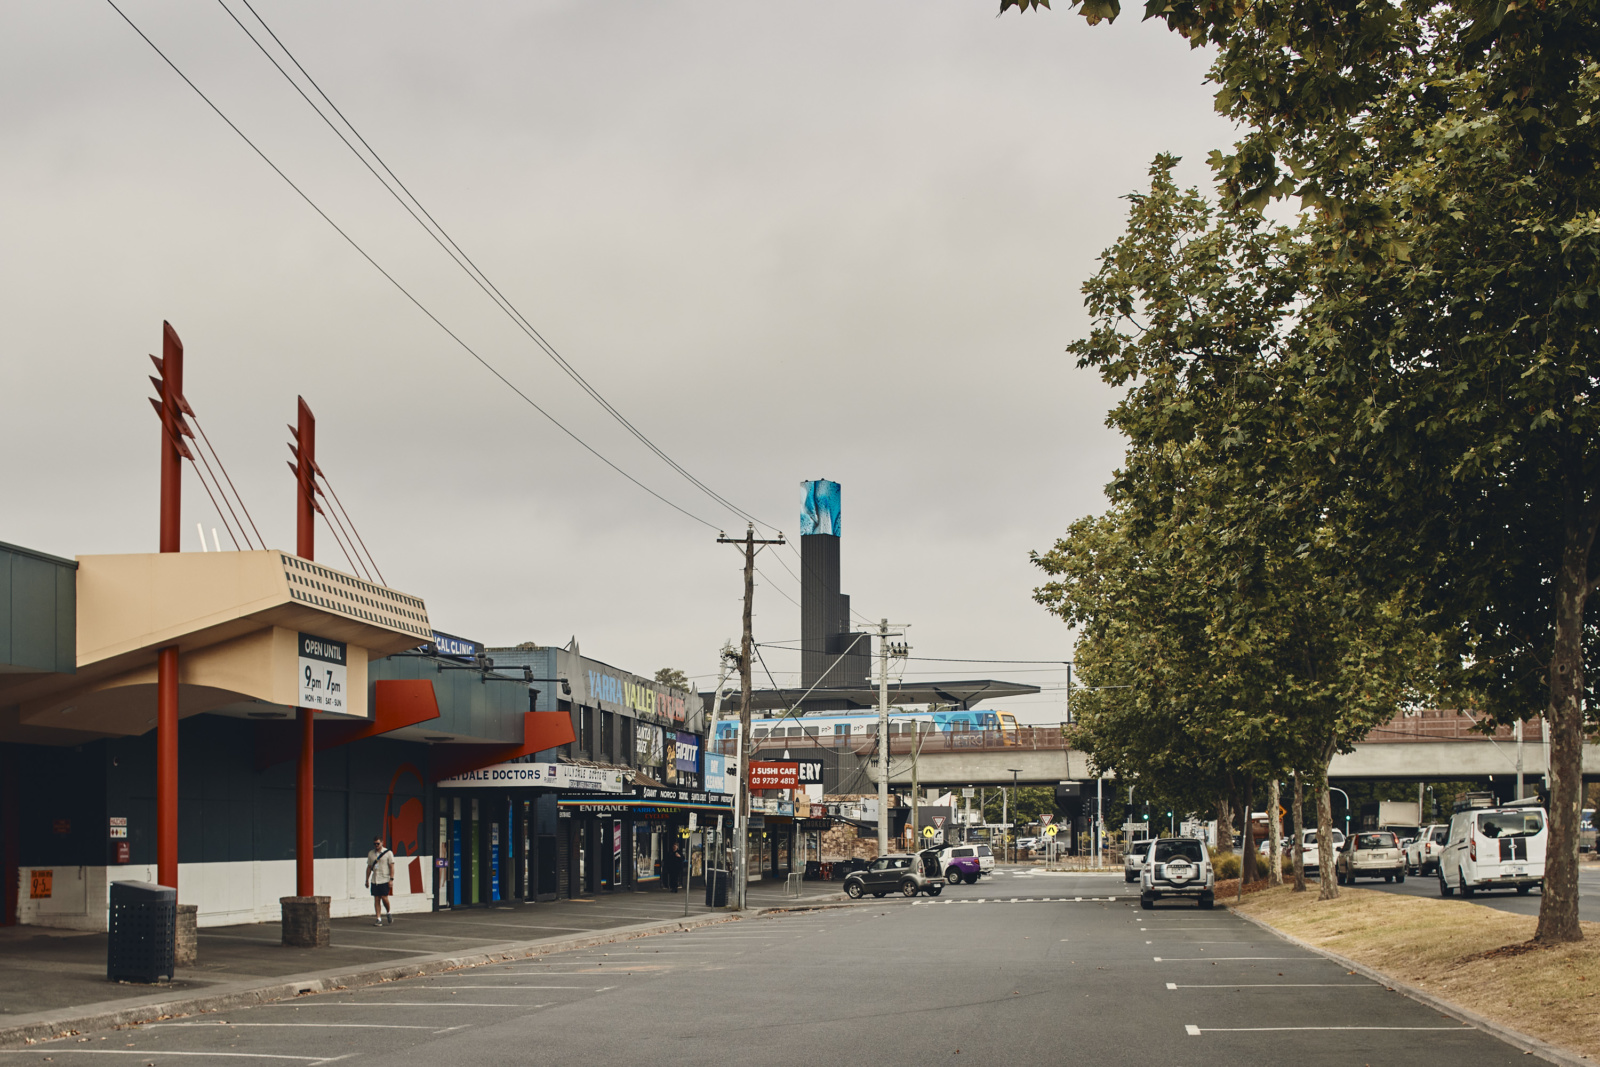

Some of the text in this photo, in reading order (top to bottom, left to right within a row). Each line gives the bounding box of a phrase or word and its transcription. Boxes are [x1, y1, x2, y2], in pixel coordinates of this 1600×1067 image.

[304, 639, 341, 660] OPEN UNTIL
[450, 641, 473, 659] CLINIC
[304, 665, 340, 695] 9pm 7pm
[304, 694, 314, 702] MON
[588, 669, 623, 706] YARRA
[624, 682, 656, 714] VALLEY
[945, 735, 983, 747] METRO
[676, 742, 698, 762] GIANT
[492, 769, 541, 780] DOCTORS
[797, 763, 822, 780] ERY
[660, 790, 677, 799] NORCO
[579, 804, 629, 812] ENTRANCE
[802, 820, 829, 828] SMOKERY
